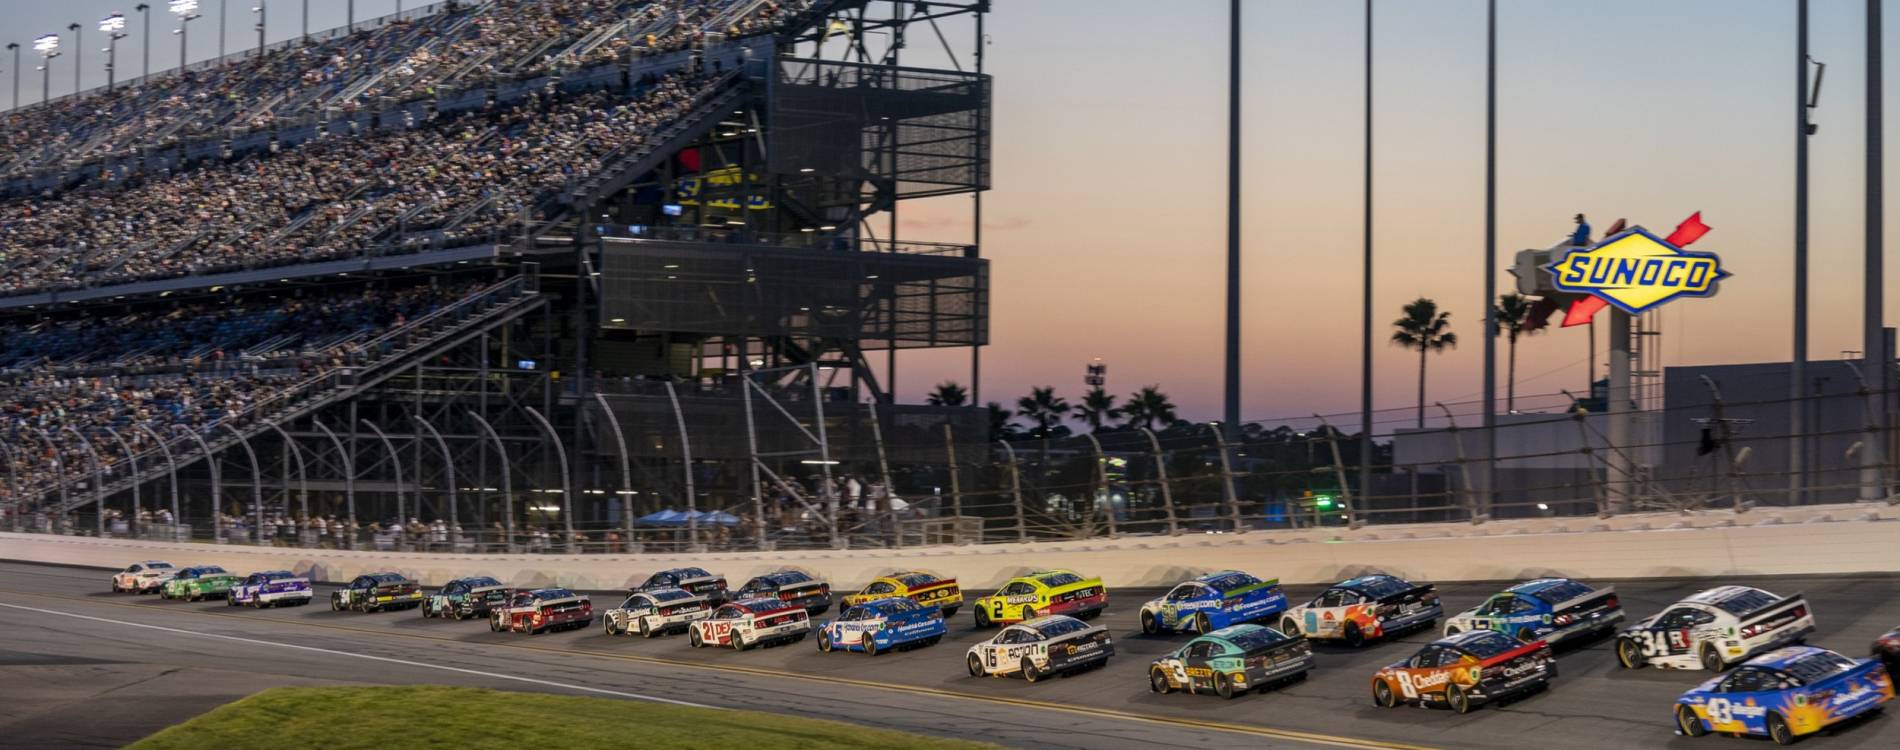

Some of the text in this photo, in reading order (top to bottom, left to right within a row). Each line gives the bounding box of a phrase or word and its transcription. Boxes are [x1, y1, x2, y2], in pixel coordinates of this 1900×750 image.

[1565, 256, 1711, 288] SUNOCO
[994, 600, 1003, 618] 2
[702, 621, 715, 641] 21
[715, 620, 732, 635] DEX
[834, 625, 843, 642] 5
[1641, 631, 1669, 656] 34
[985, 648, 997, 667] 16
[1168, 659, 1188, 683] 3
[1395, 670, 1418, 698] 8
[1706, 697, 1733, 724] 43
